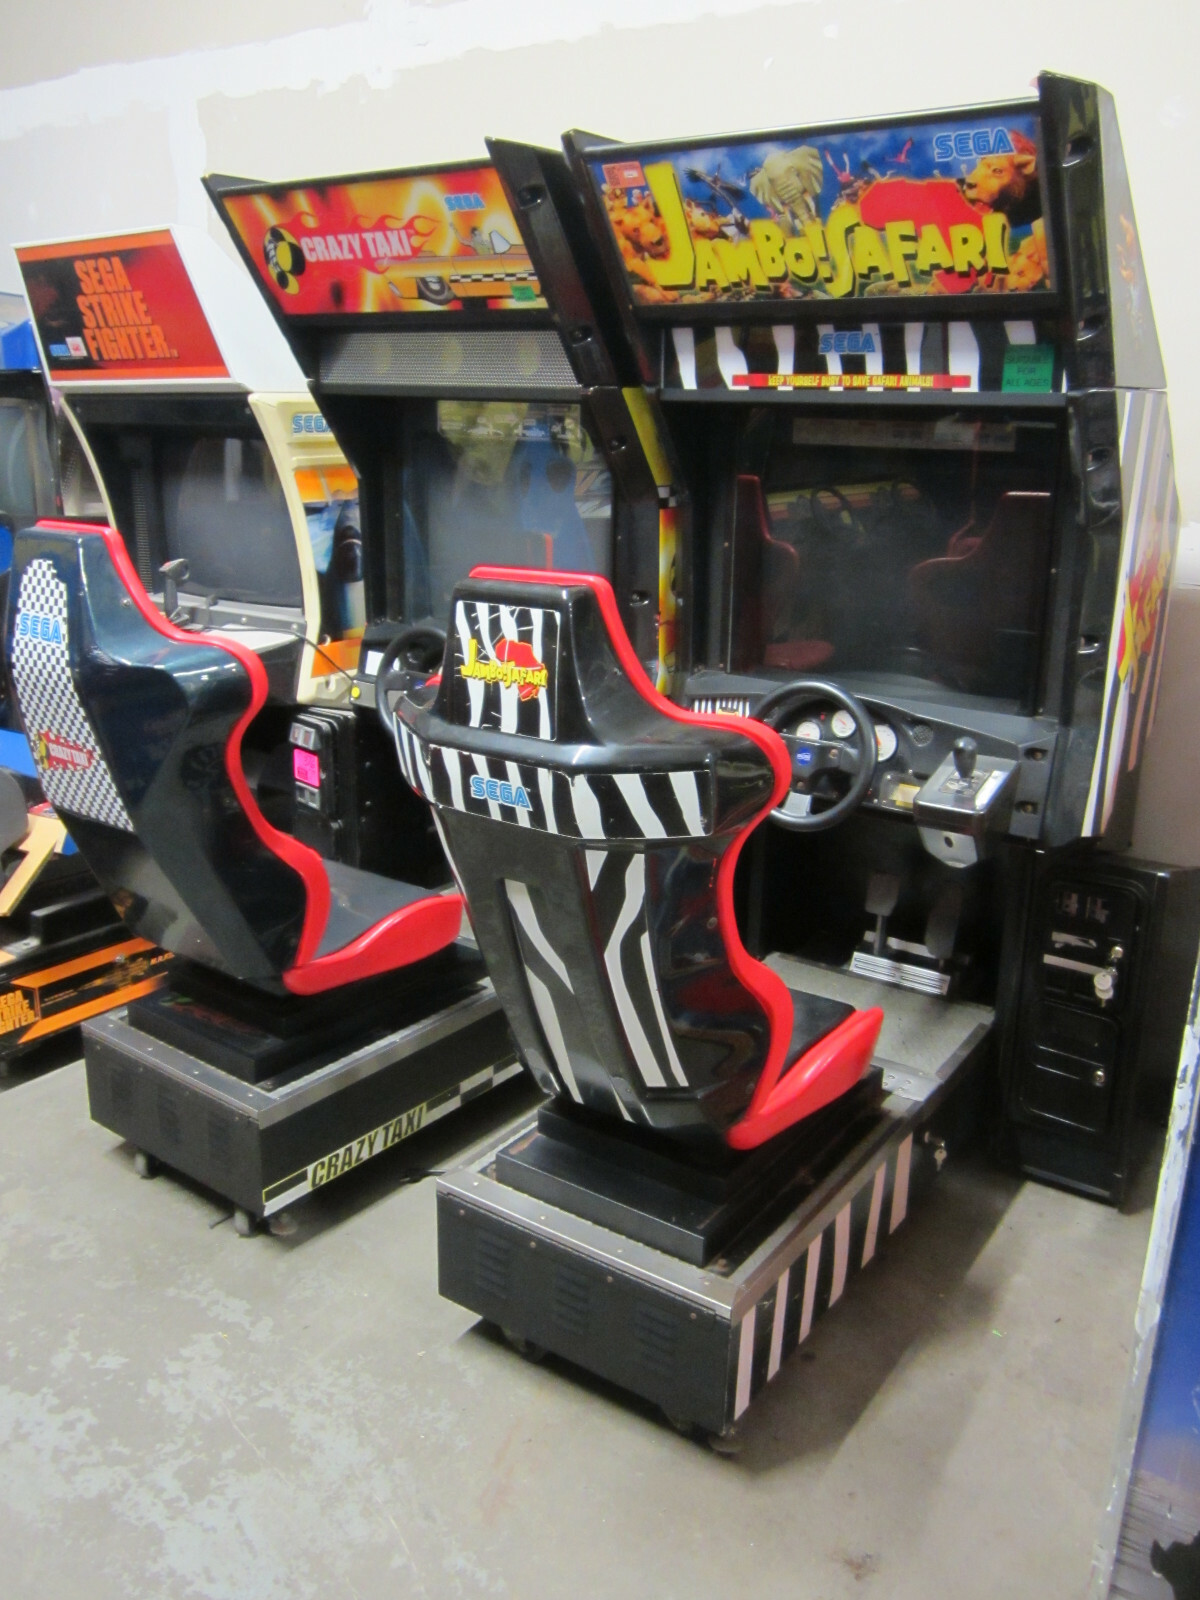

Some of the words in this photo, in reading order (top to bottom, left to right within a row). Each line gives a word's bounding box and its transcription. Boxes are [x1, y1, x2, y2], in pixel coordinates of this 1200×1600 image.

[934, 128, 1015, 161] SEGA
[444, 193, 486, 211] SEGA
[301, 232, 363, 263] CRAZY
[362, 229, 413, 258] TAXI
[73, 256, 132, 294] SEGA
[76, 290, 152, 328] STRIKE
[819, 332, 876, 353] SEGA
[786, 375, 819, 386] YOURSELF
[842, 375, 850, 386] TO
[19, 612, 62, 644] SEGA
[471, 775, 532, 811] SEGA
[310, 1130, 379, 1189] CRAZY
[382, 1104, 425, 1149] TAXI
